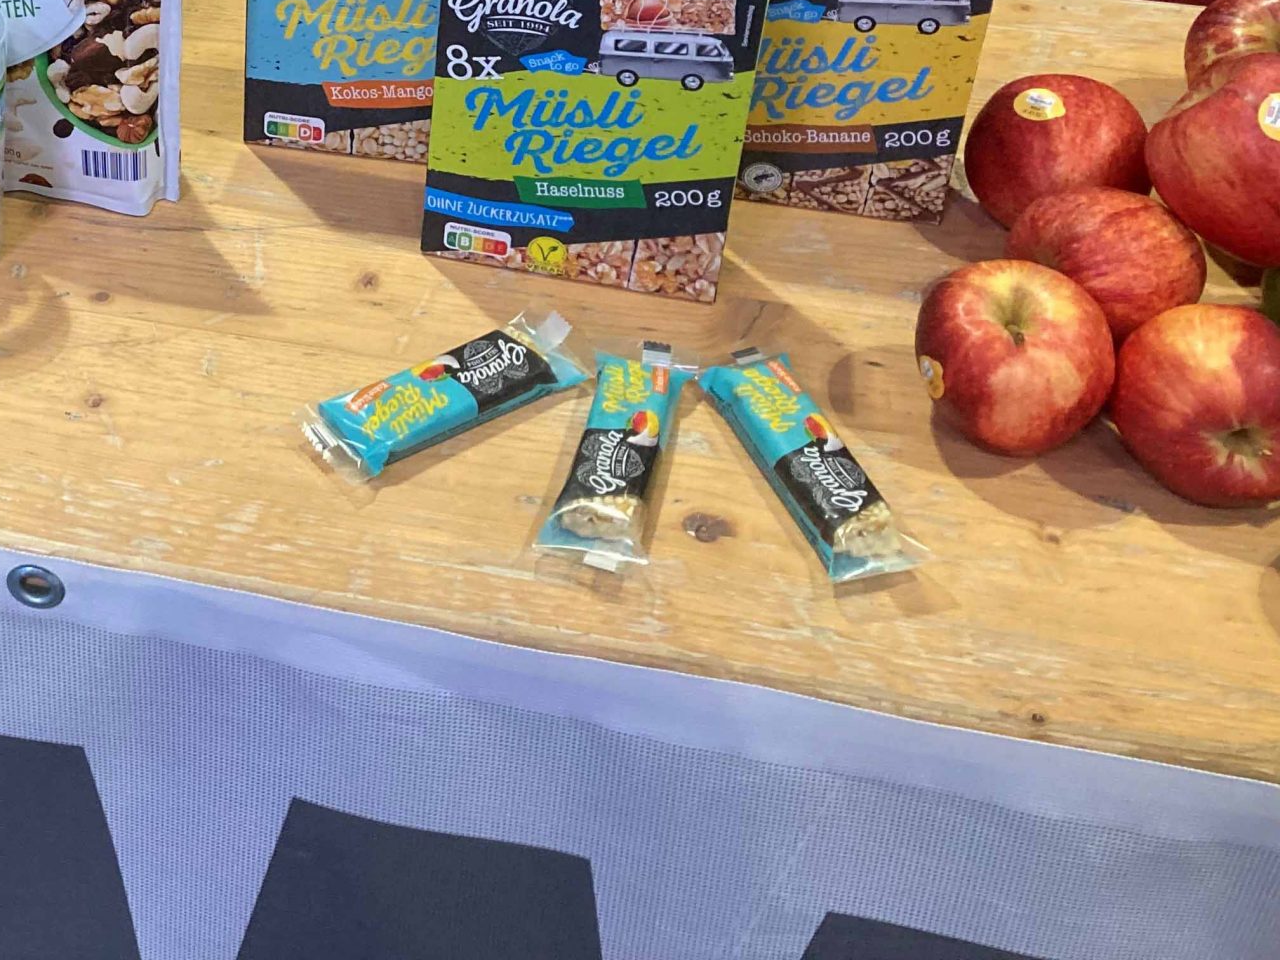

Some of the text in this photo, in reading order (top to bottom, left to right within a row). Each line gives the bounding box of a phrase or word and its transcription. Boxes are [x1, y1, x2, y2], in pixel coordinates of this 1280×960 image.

[788, 8, 818, 22] to go
[486, 18, 552, 34] SEIT 1994
[446, 44, 505, 82] 8x
[528, 53, 566, 69] Snack
[760, 34, 879, 75] üsli
[549, 60, 580, 73] to go
[330, 84, 434, 101] Kokos-Mango
[750, 66, 936, 121] Riegel
[464, 85, 644, 132] Müsli
[744, 129, 871, 145] Schoko-Banane
[884, 129, 951, 148] 200 g
[504, 123, 702, 178] Riegel
[535, 181, 625, 200] Haselnuss
[654, 189, 723, 209] 200 g
[427, 194, 464, 214] OHNE
[526, 263, 566, 276] VEGAN
[457, 338, 527, 386] Granola
[362, 383, 422, 441] Riegel
[390, 387, 450, 440] Müsli
[589, 429, 627, 495] Granola
[800, 445, 868, 513] Granola
